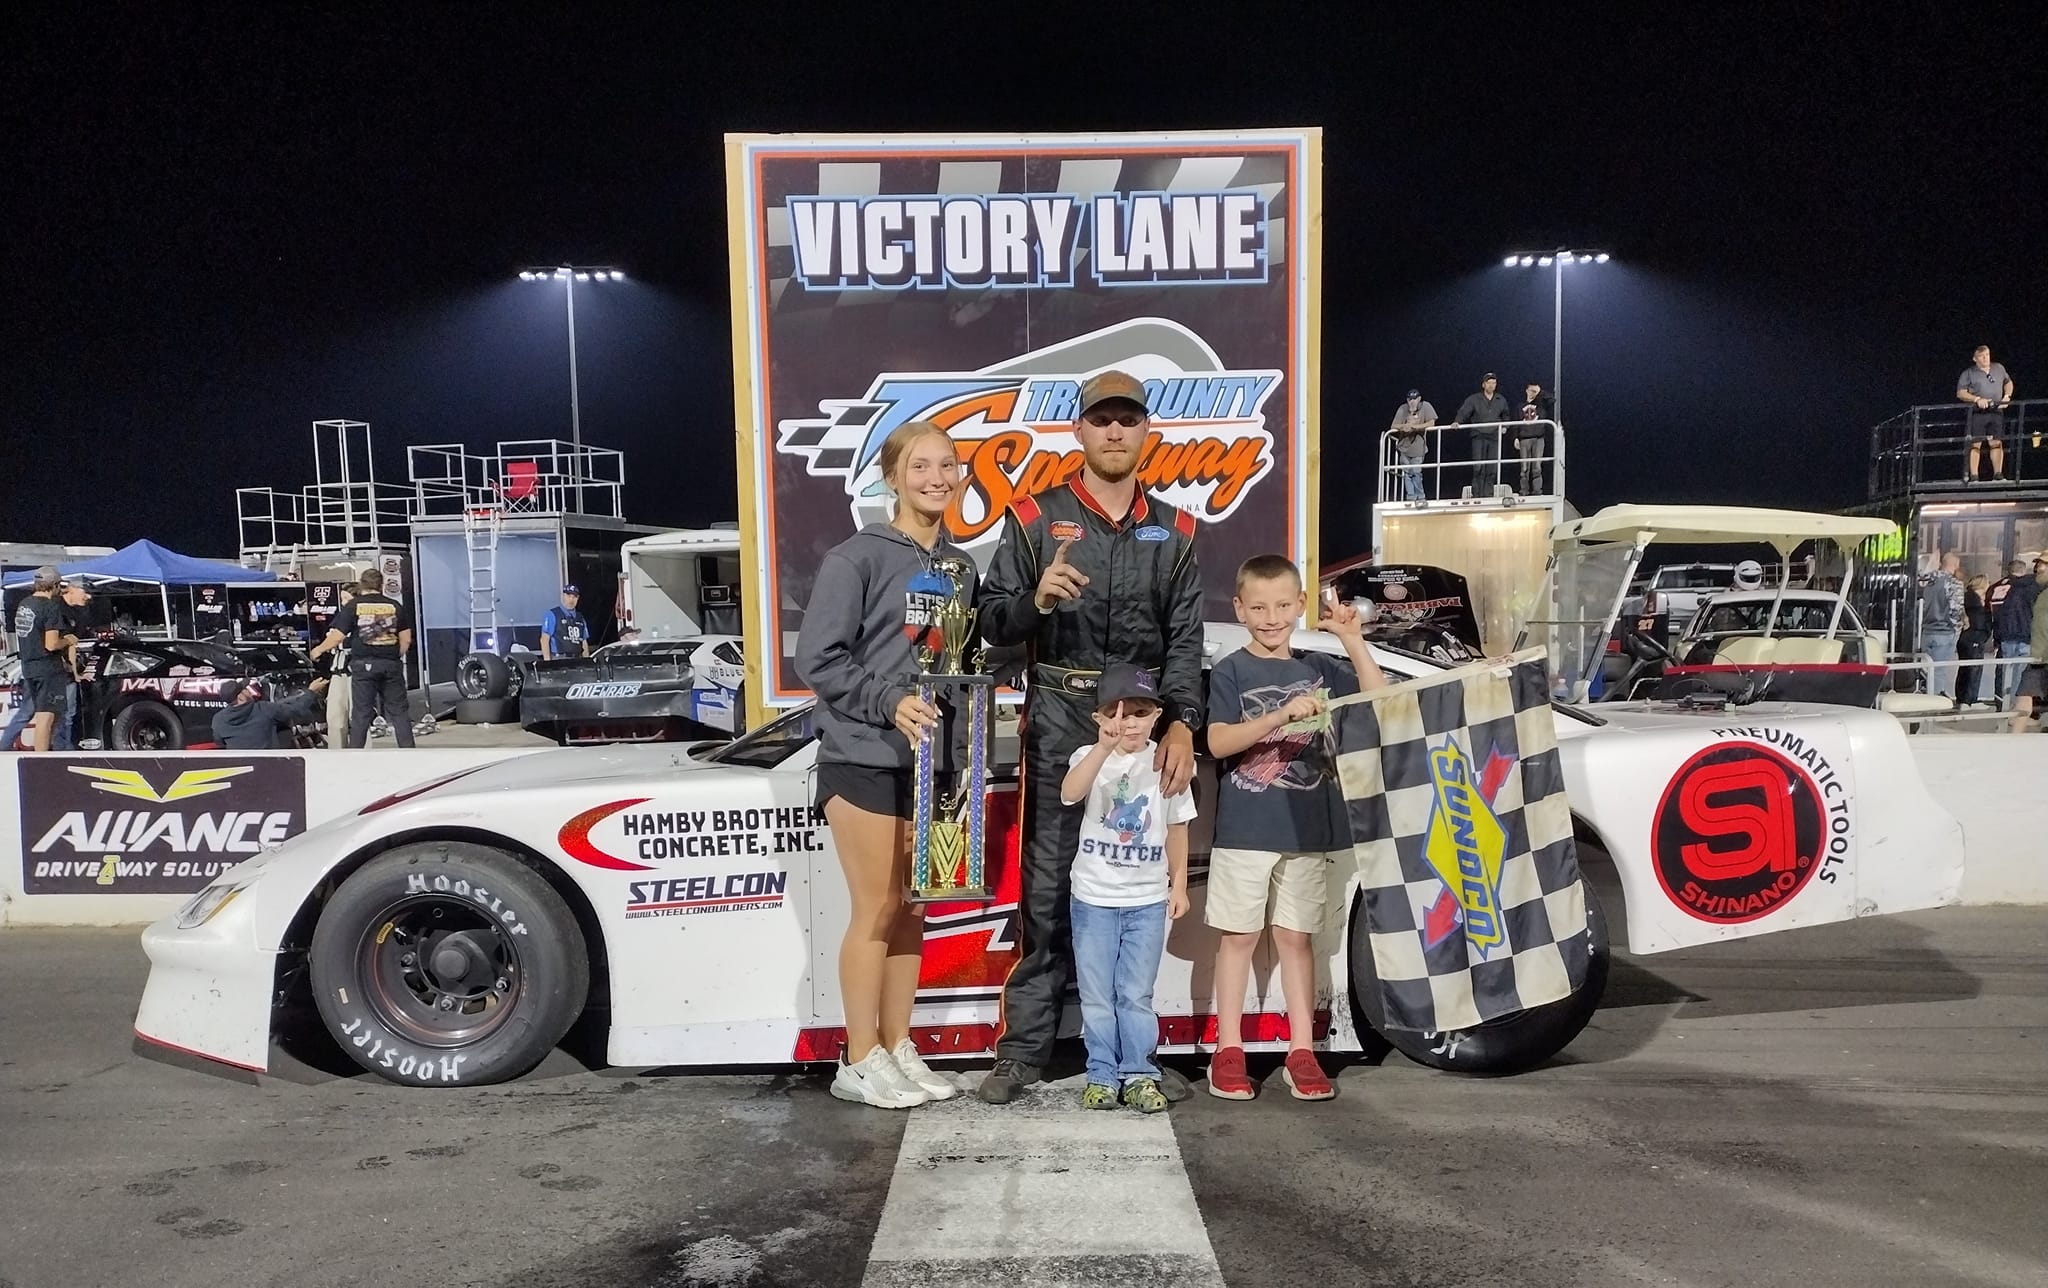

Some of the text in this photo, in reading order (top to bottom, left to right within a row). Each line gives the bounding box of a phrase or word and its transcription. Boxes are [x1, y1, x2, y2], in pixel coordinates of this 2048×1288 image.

[789, 193, 1262, 285] VICTORY LANE
[1141, 375, 1277, 419] OUNTY
[942, 430, 1267, 541] Speway
[905, 592, 945, 610] LET'S
[1711, 726, 1844, 798] PNEUMATIC
[31, 810, 292, 852] ALLIANCE
[622, 806, 830, 836] HAMBY BROTHER
[1818, 799, 1850, 884] TOOLS
[638, 829, 824, 860] CONCRETE, INC.
[1082, 838, 1163, 862] STITCH
[1437, 752, 1497, 937] SUNOCO
[162, 861, 240, 878] SOLUT
[627, 871, 788, 905] STEELCON
[1679, 871, 1797, 914] SHINANO
